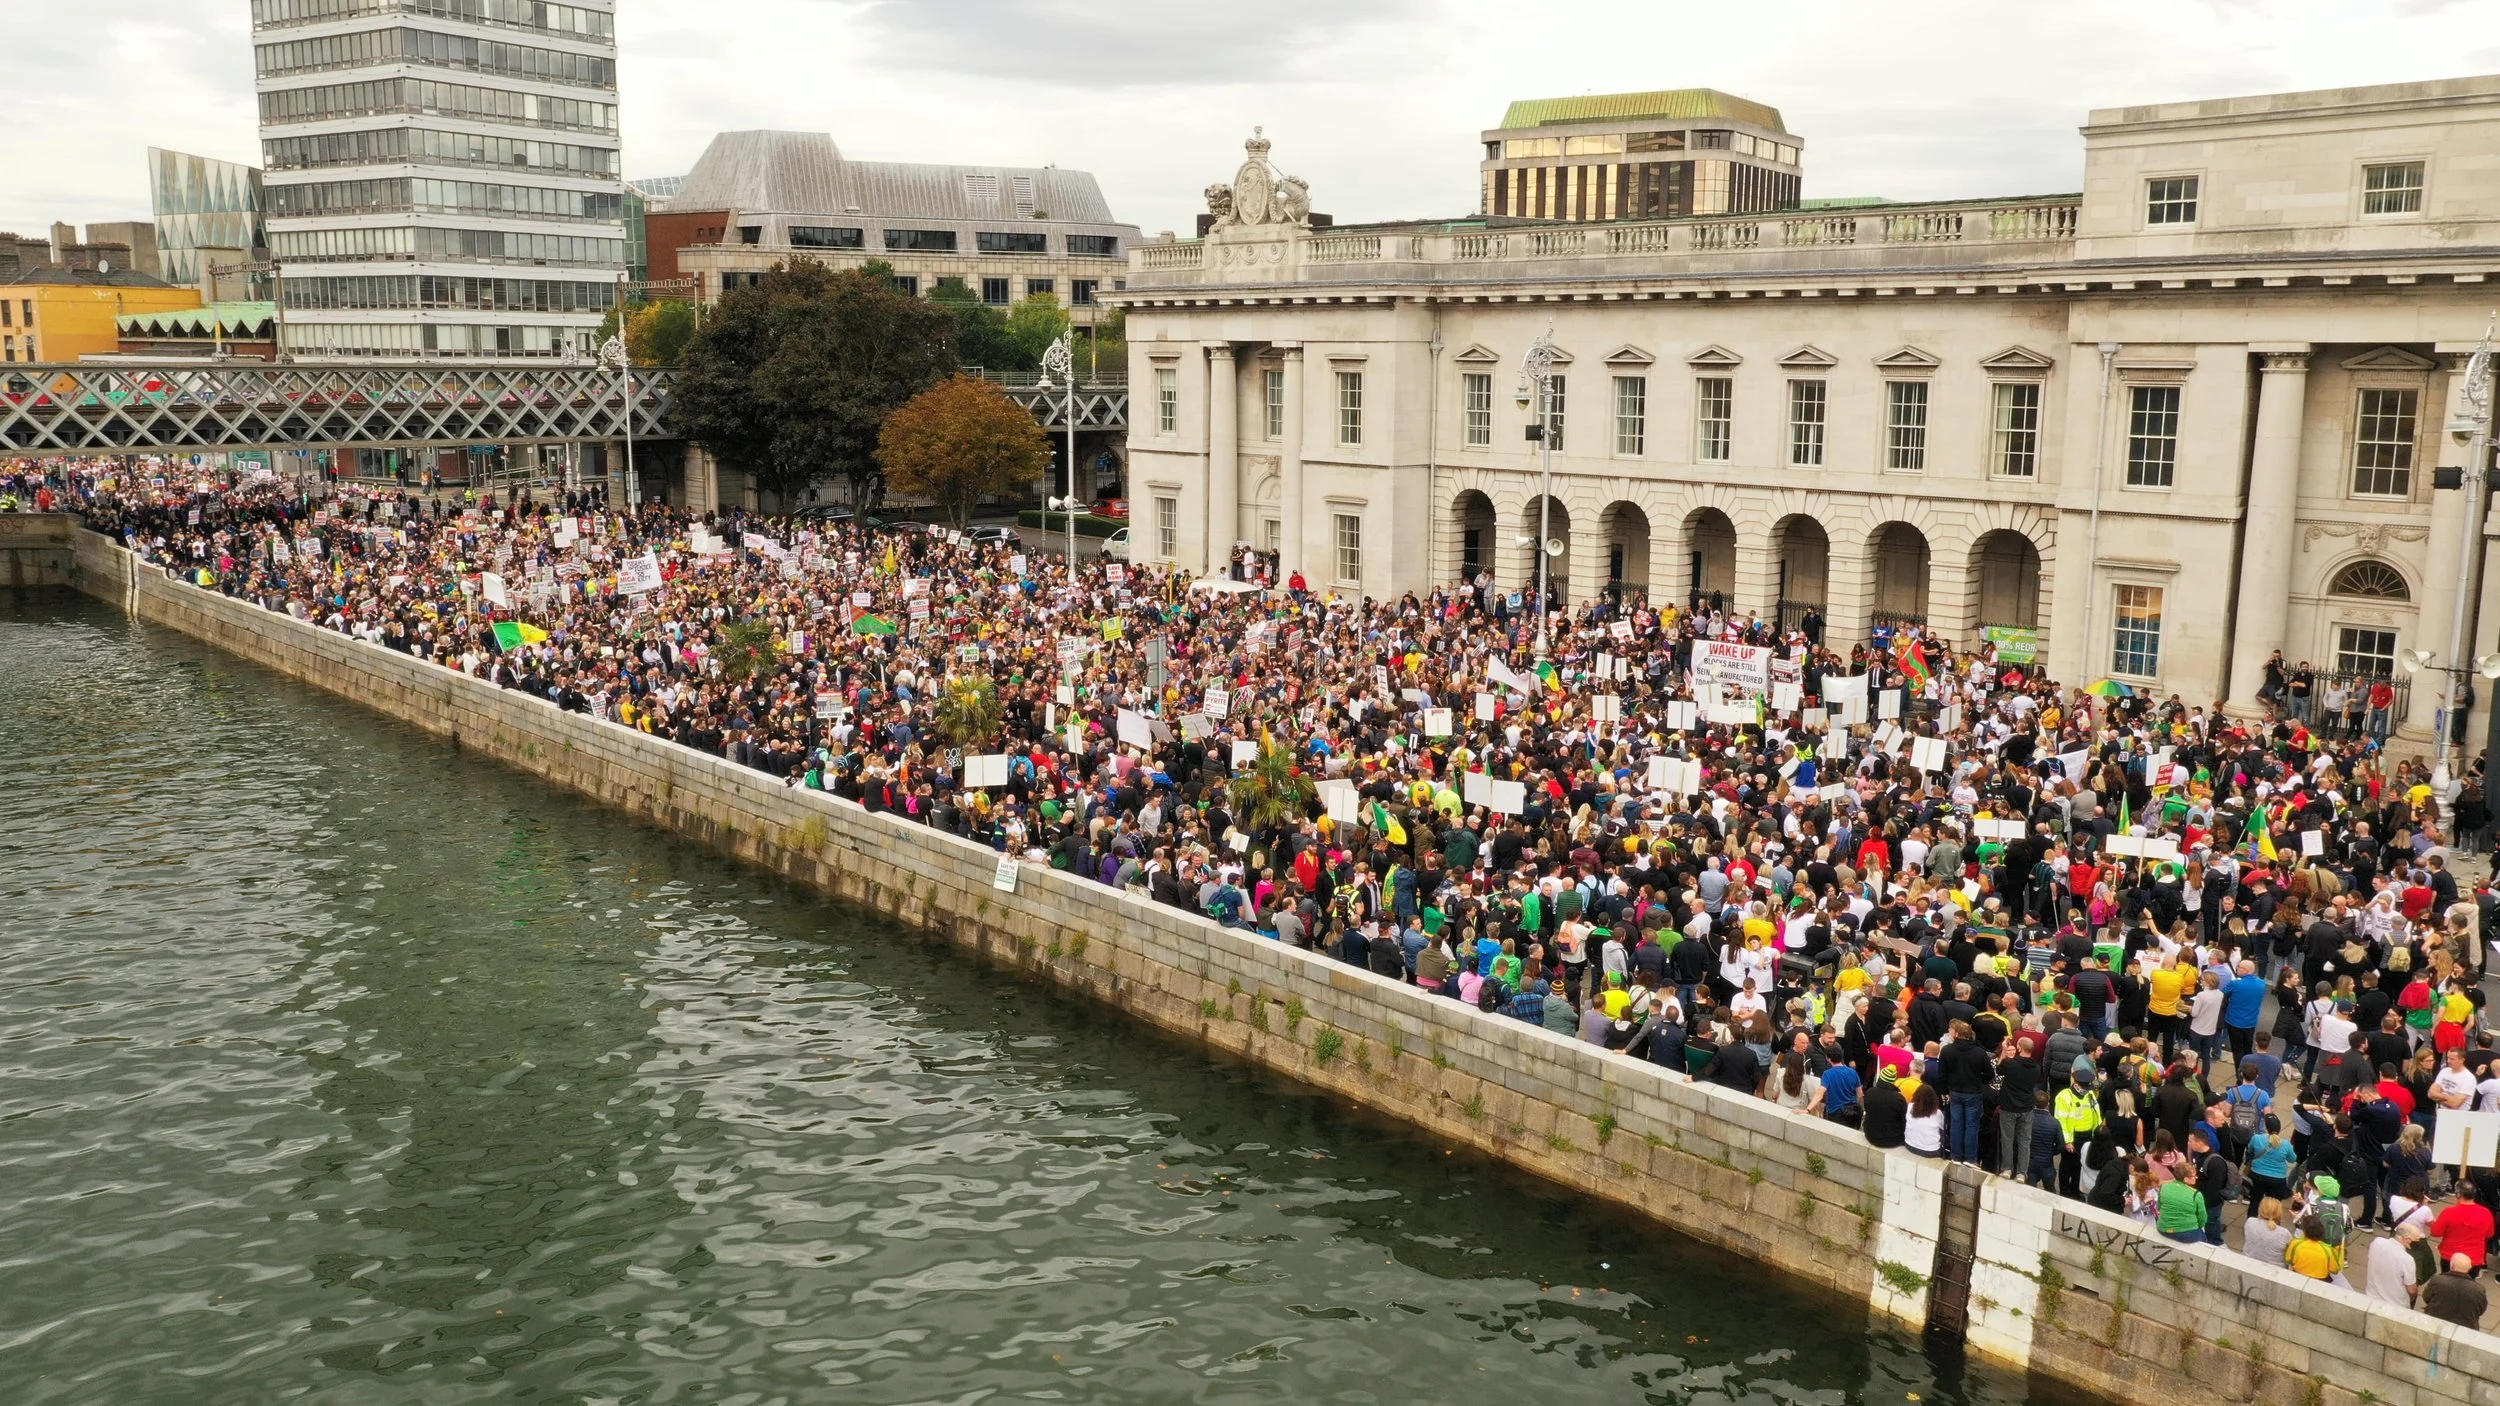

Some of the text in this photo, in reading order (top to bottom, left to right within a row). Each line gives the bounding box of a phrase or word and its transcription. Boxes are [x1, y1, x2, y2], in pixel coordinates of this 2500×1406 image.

[1708, 643, 1756, 659] WAKE UP
[1696, 667, 1710, 676] BEIN
[1728, 661, 1740, 670] ARE
[1741, 663, 1756, 672] STILL
[1206, 696, 1226, 705] PYRITE
[944, 747, 961, 759] 00%
